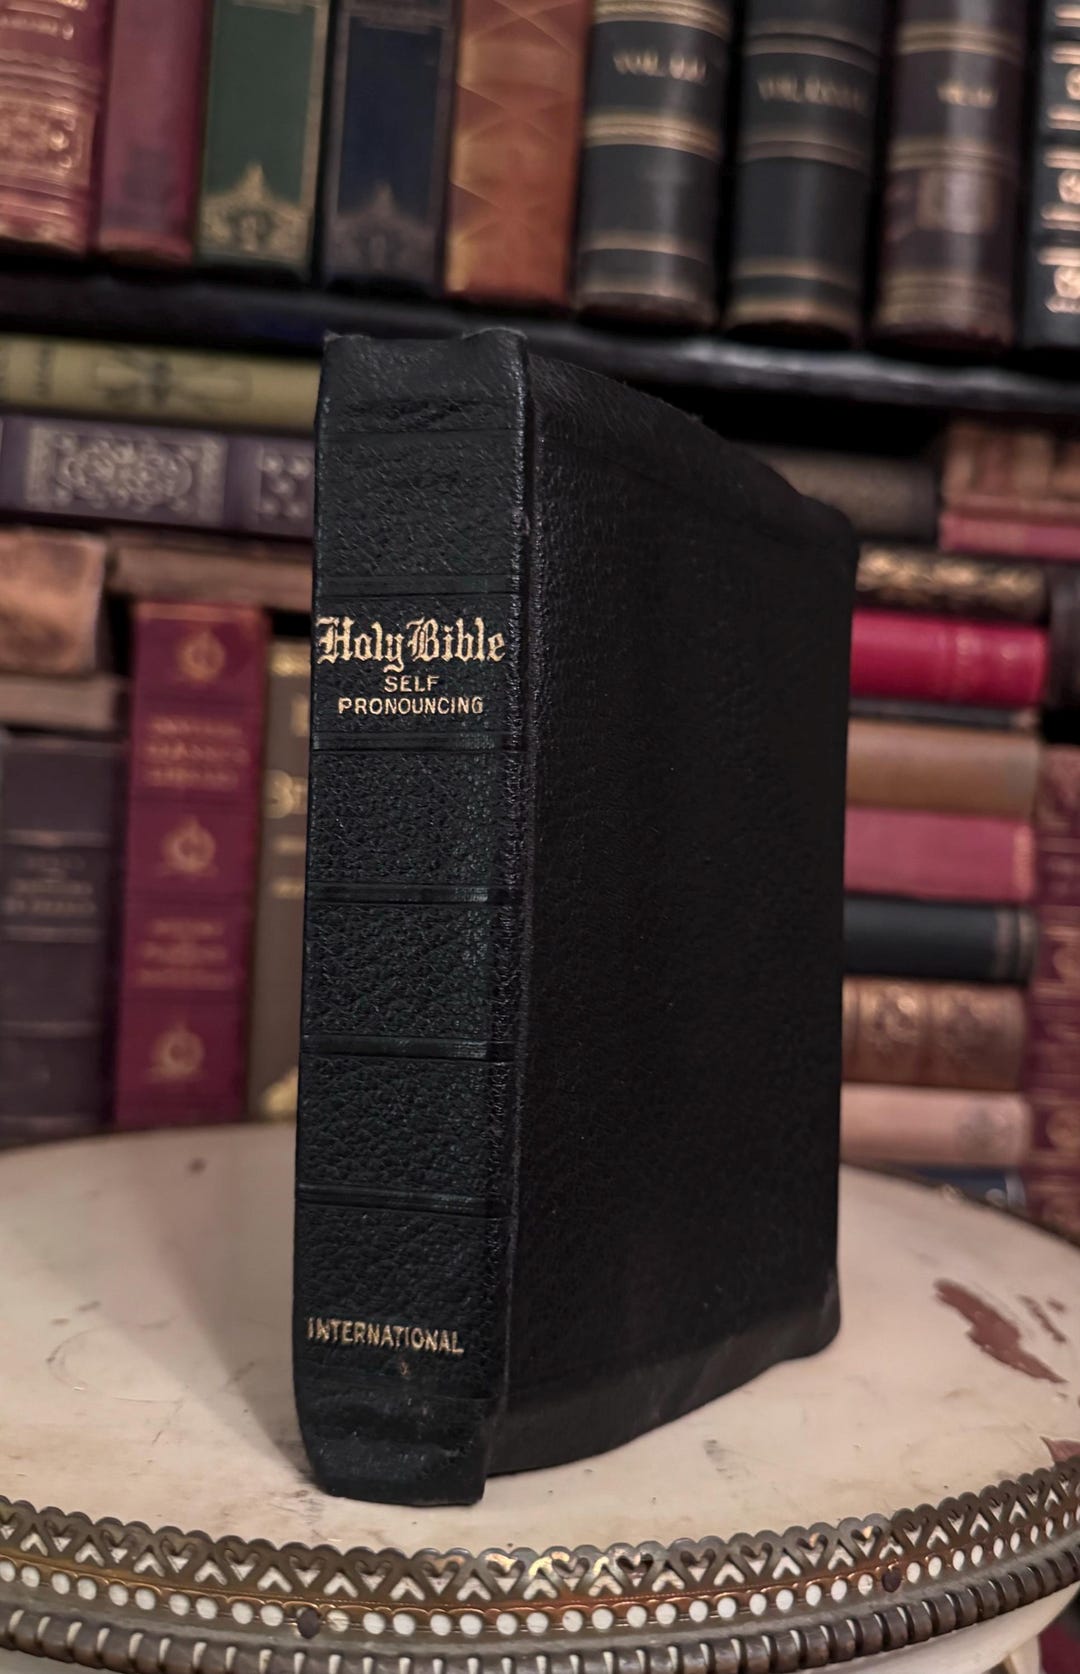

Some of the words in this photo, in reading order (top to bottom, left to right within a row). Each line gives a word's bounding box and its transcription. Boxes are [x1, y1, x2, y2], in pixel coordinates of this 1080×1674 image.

[316, 616, 404, 673] Holy
[406, 616, 506, 662] Bible
[384, 674, 440, 693] SELF
[337, 696, 484, 715] PRONOUNCING
[306, 1317, 465, 1354] INTERNATIONAL
